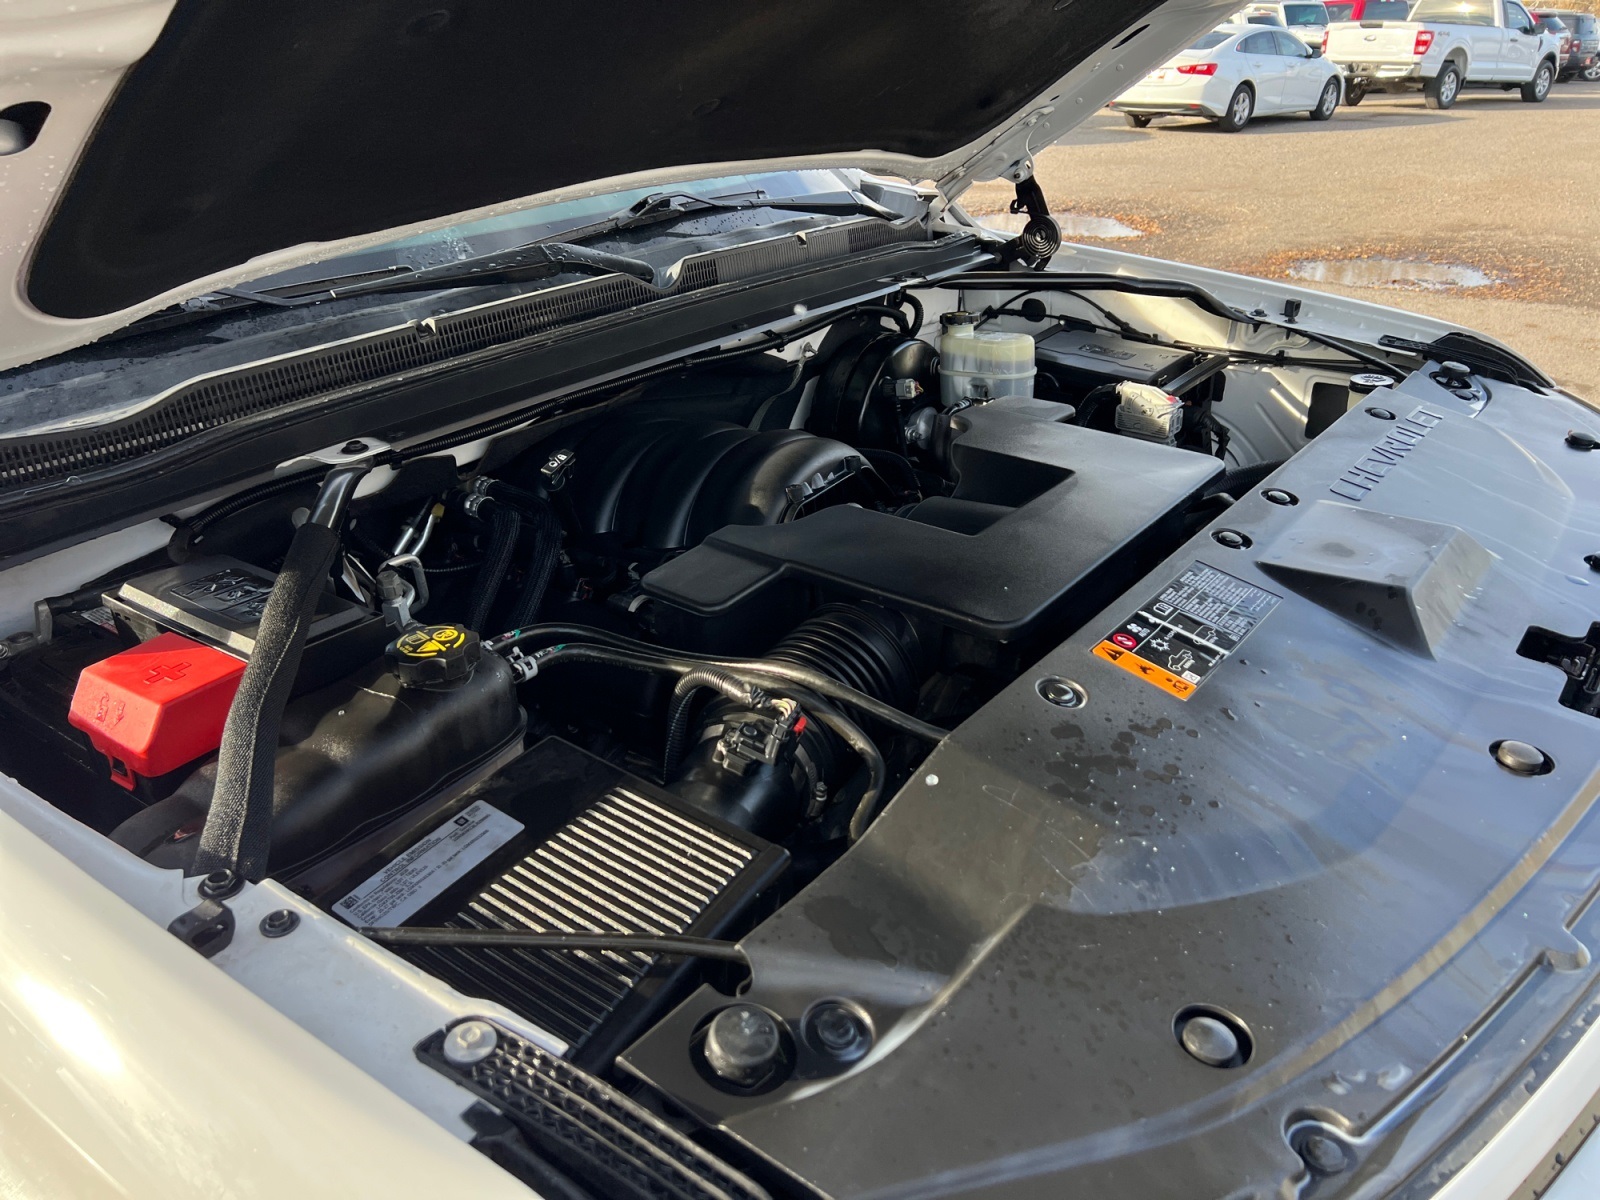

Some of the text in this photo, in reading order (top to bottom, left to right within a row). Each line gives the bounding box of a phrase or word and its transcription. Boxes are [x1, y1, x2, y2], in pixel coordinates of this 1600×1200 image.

[1329, 405, 1444, 502] CHEVROLET
[380, 862, 407, 883] CONTROL
[406, 837, 442, 863] INFORMATION
[383, 838, 432, 874] VEHICLE EMISSION
